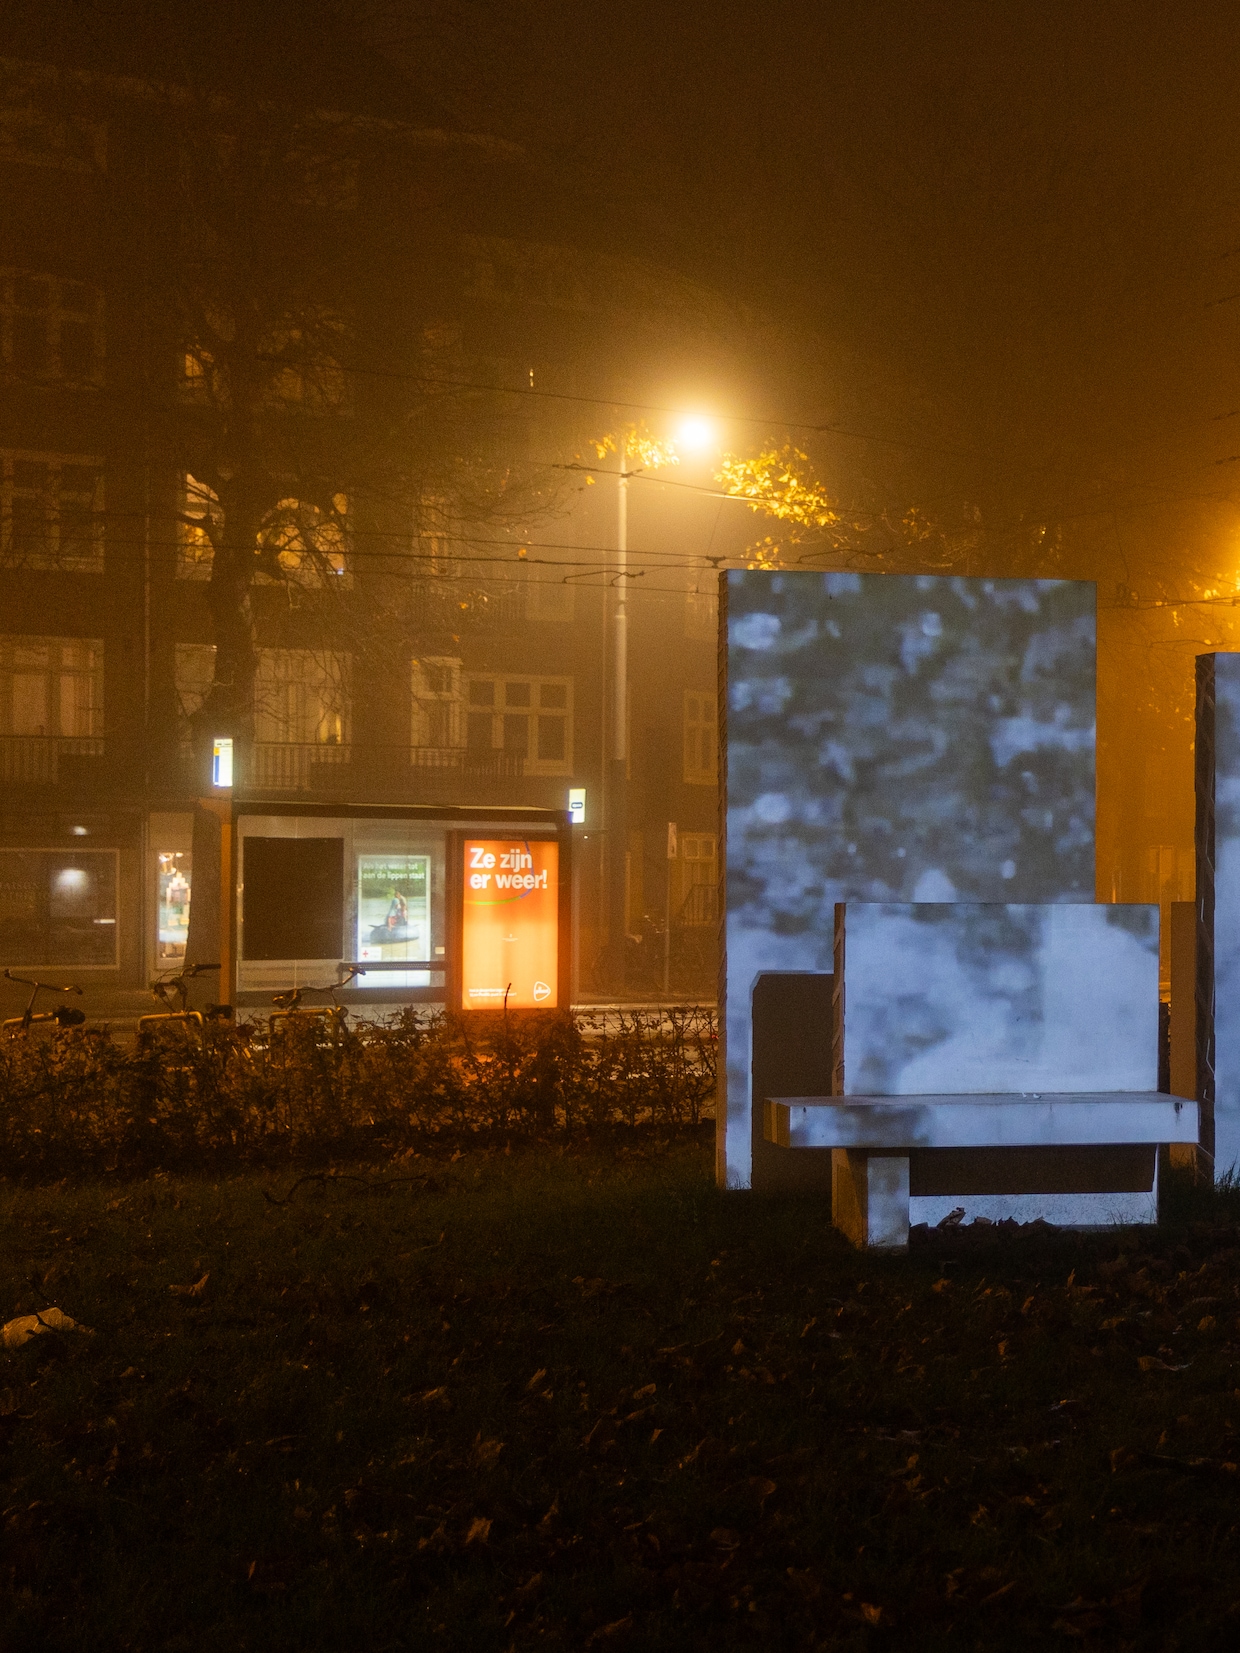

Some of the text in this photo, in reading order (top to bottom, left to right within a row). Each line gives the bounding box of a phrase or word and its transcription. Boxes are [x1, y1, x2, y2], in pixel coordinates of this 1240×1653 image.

[470, 847, 533, 872] Ze zijn
[376, 871, 387, 879] de
[387, 871, 408, 880] lippen
[470, 869, 548, 889] er weer!
